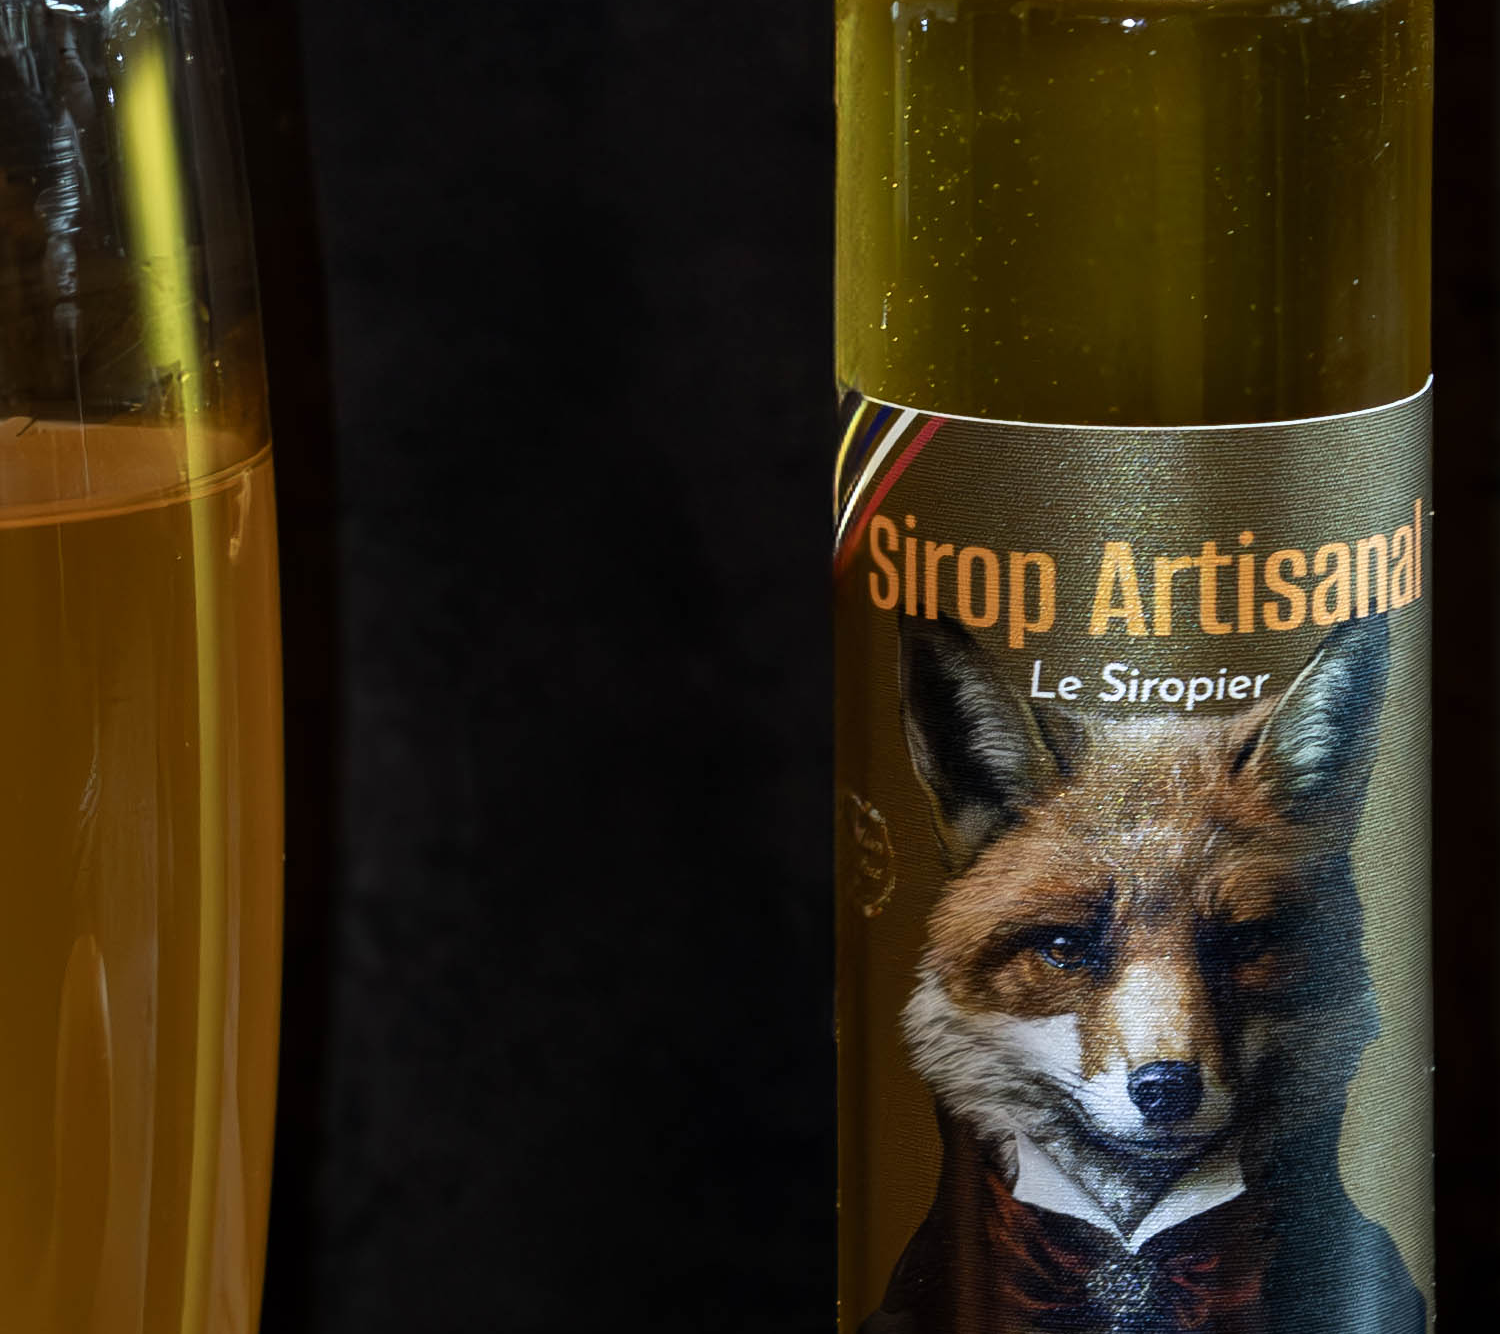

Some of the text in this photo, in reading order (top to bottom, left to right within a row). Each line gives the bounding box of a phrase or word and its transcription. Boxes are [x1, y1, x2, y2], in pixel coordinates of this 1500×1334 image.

[868, 498, 1423, 649] Sirop Artisanal
[1030, 660, 1271, 711] Le Siropier
